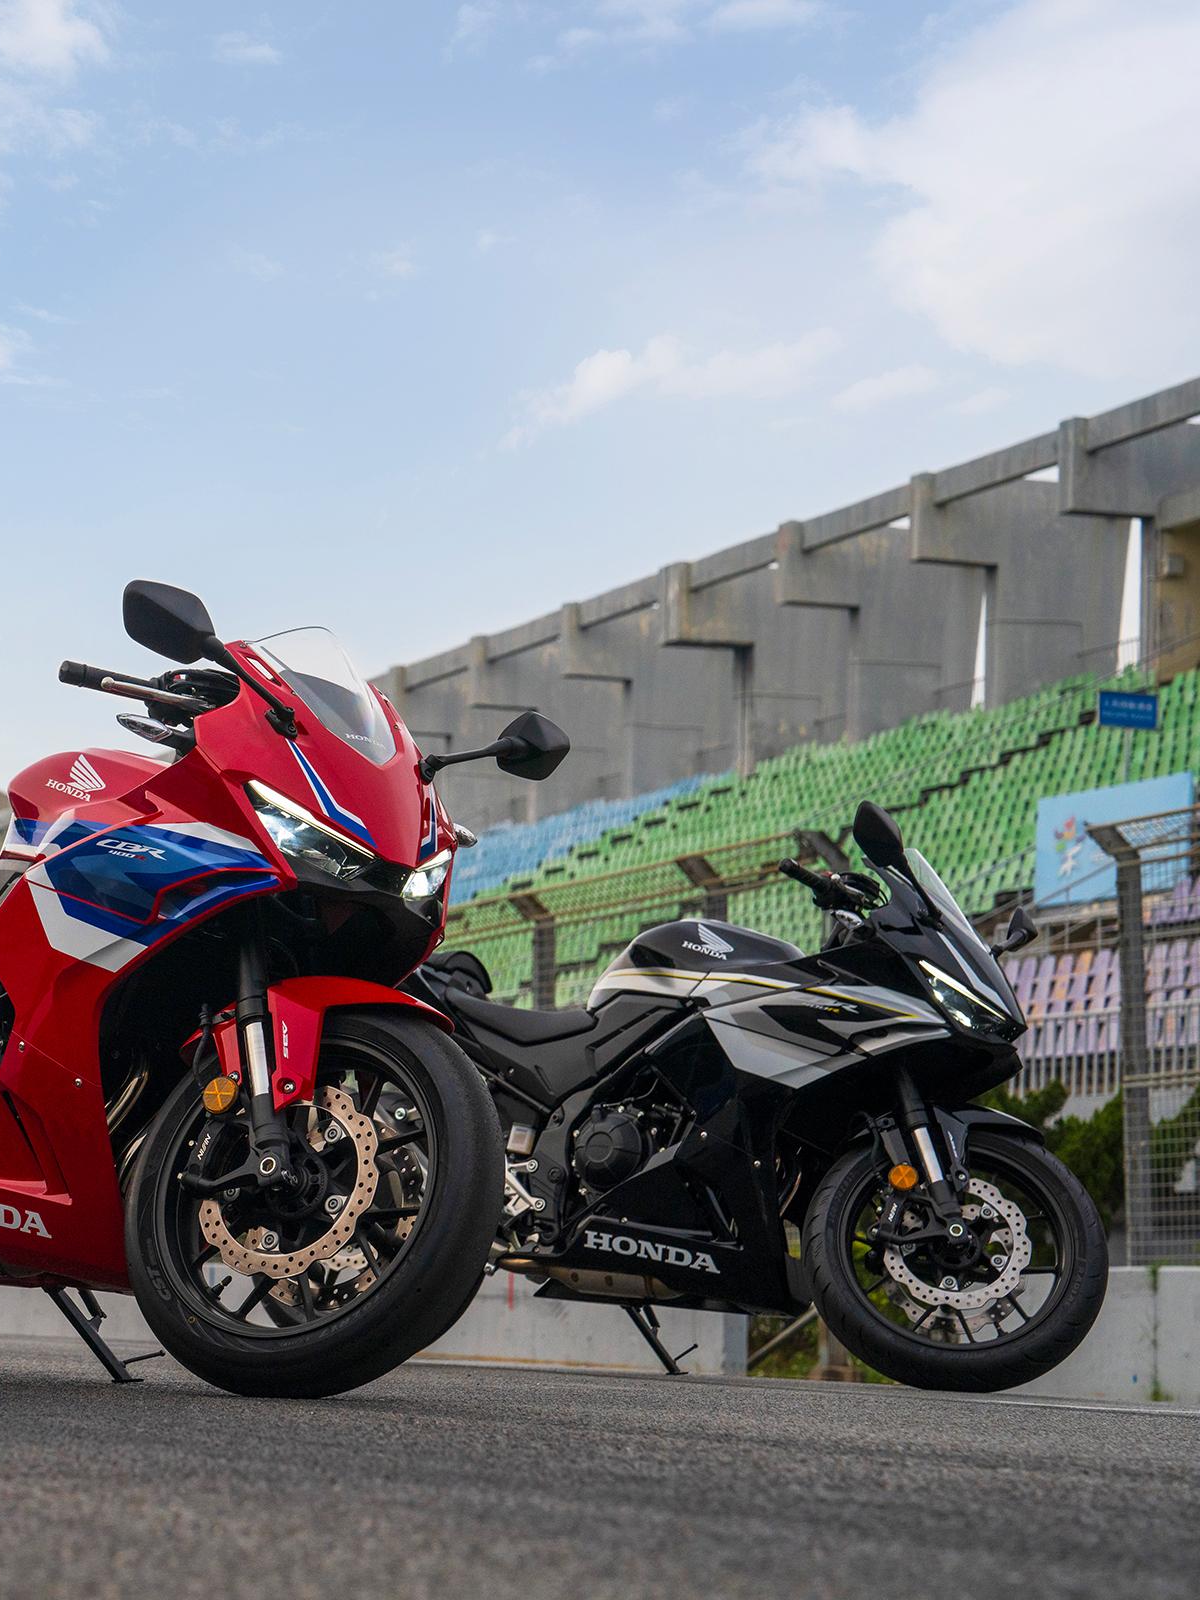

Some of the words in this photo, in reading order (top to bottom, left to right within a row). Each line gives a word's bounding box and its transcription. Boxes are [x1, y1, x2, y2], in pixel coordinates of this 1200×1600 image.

[45, 778, 91, 802] HONDA
[95, 838, 168, 861] CBR
[681, 940, 727, 960] HONDA
[281, 1019, 289, 1059] ABS
[583, 1230, 721, 1274] HONDA
